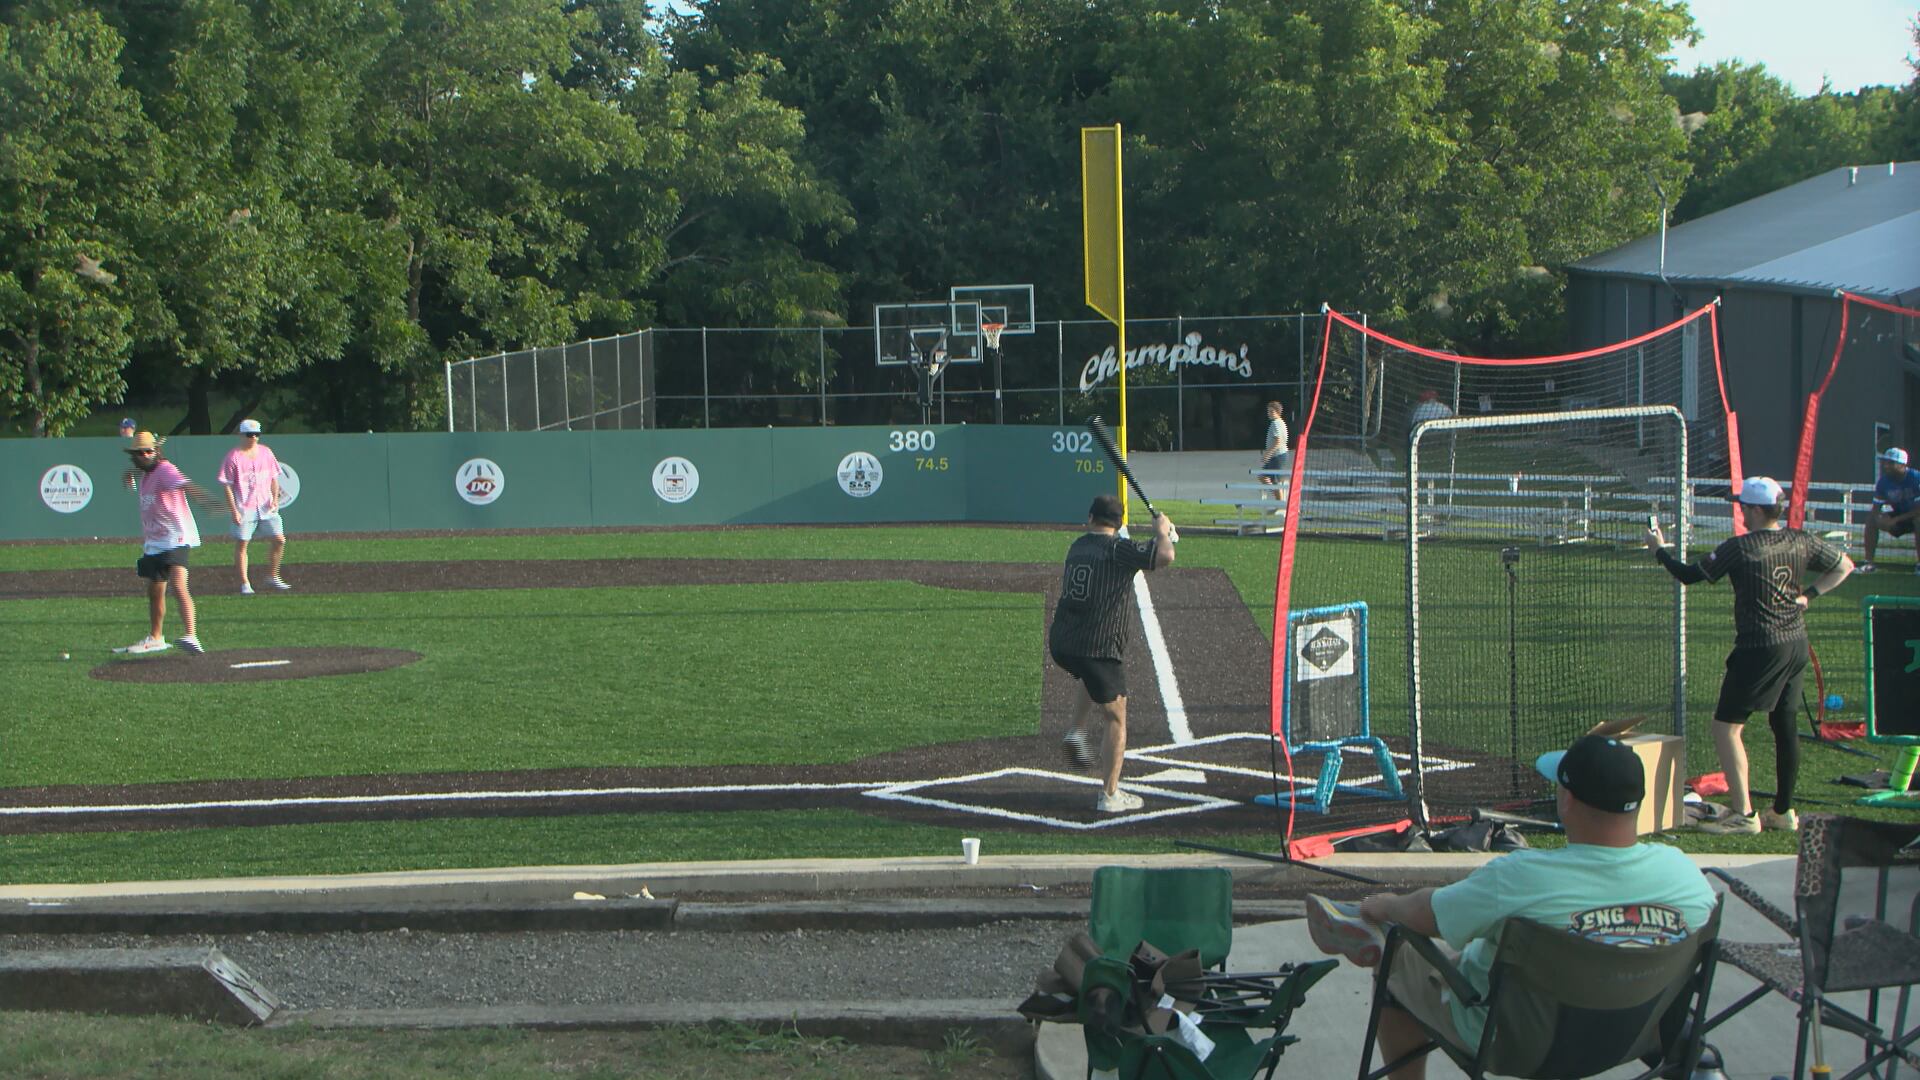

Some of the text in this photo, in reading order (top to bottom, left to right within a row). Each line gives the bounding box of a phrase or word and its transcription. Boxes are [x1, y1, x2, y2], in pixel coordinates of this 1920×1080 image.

[889, 430, 935, 452] 380
[1051, 431, 1093, 453] 302
[915, 457, 949, 470] 74.5
[1075, 459, 1104, 473] 70.5
[470, 481, 492, 493] DQ
[1070, 564, 1093, 601] 9
[1772, 565, 1793, 605] 2
